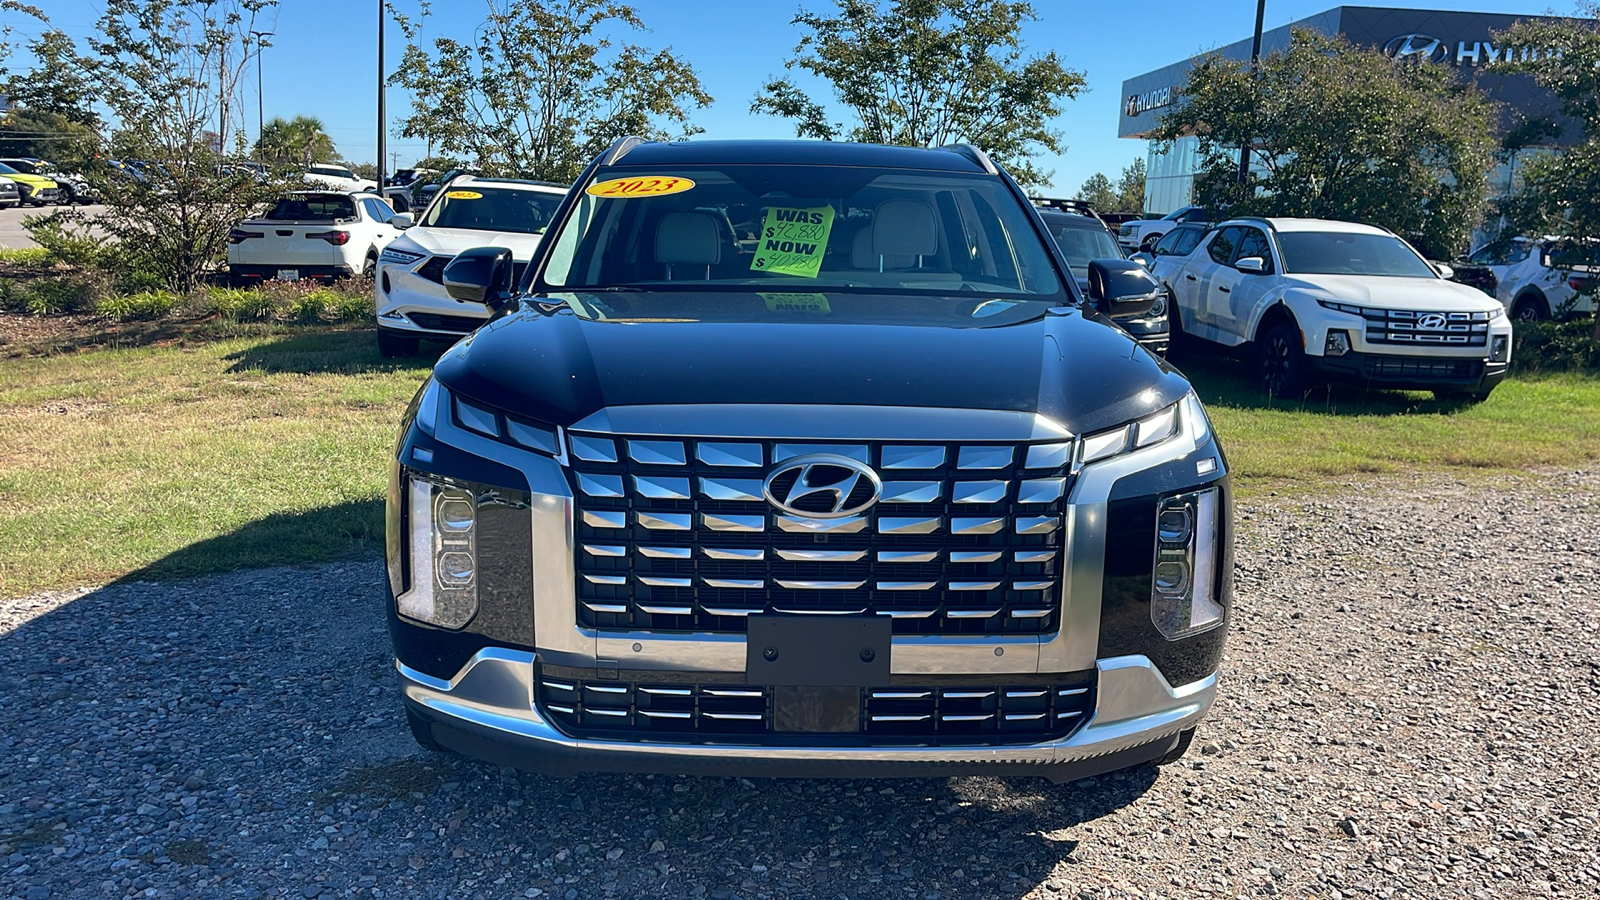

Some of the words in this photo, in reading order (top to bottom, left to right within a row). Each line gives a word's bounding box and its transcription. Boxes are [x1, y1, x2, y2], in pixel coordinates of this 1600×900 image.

[1136, 86, 1170, 112] HYUNDAI
[603, 179, 679, 195] 2023
[776, 209, 823, 224] WAS
[765, 240, 818, 255] NOW
